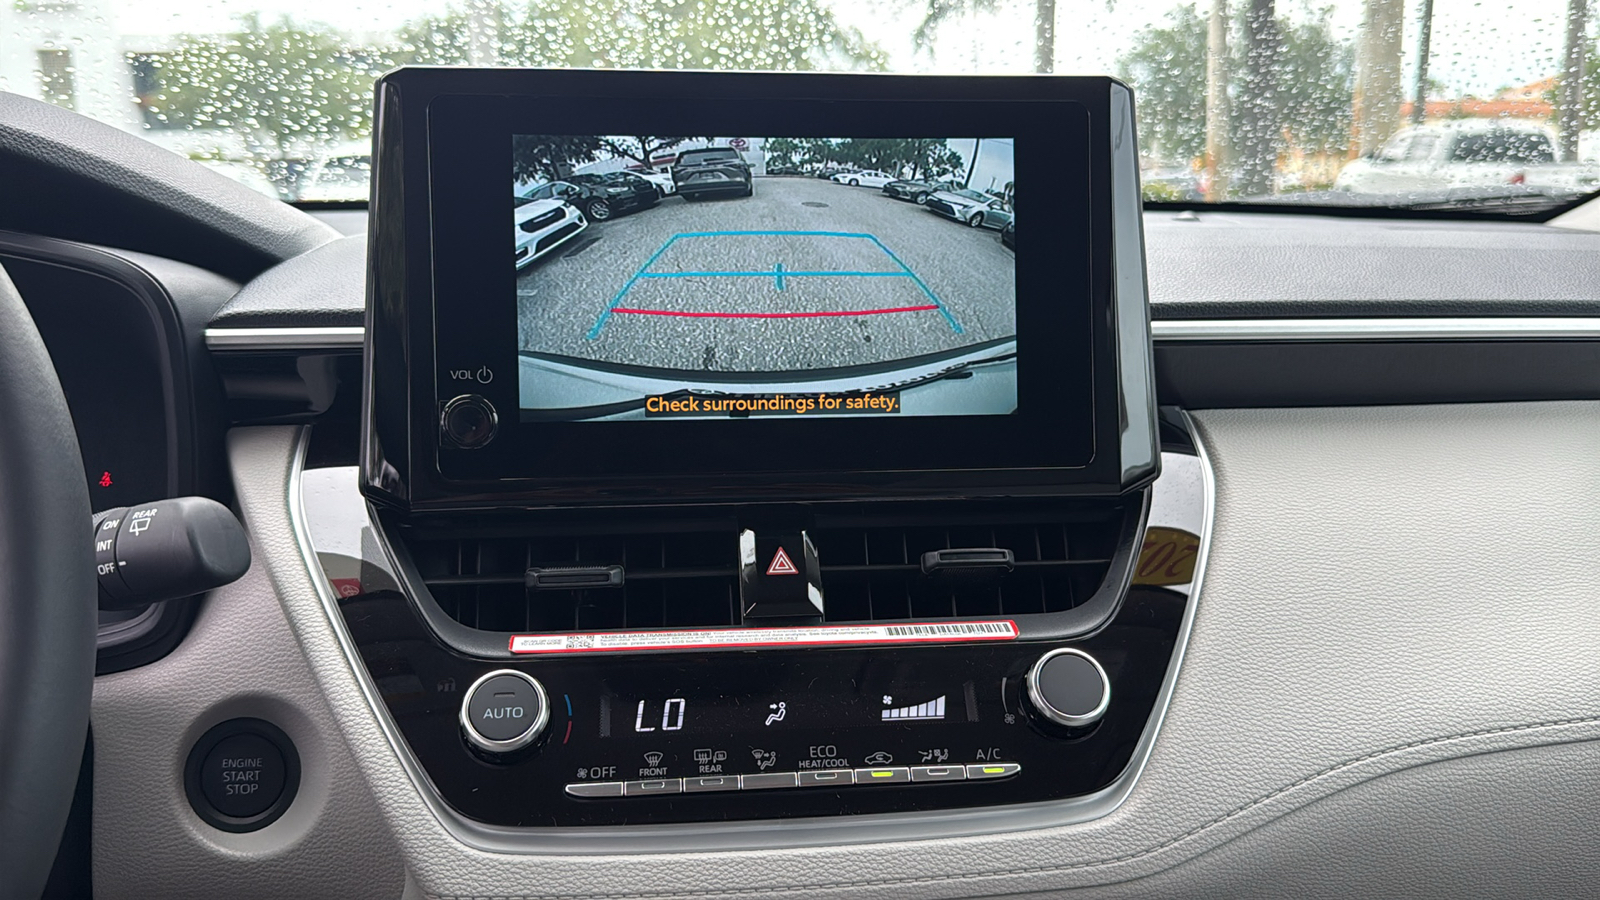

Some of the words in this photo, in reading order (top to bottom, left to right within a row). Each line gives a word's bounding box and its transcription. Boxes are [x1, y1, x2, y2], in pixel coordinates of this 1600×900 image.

[450, 369, 474, 380] VOL
[645, 395, 700, 413] Check
[702, 394, 815, 415] surroundings
[818, 393, 843, 411] for
[845, 393, 900, 414] safety.
[132, 508, 158, 520] REAR
[102, 519, 120, 530] ON
[96, 539, 113, 552] INT
[97, 562, 115, 575] OFF
[482, 706, 524, 719] AUTO
[809, 745, 837, 758] ECO
[976, 747, 1001, 761] A/C
[221, 757, 263, 769] ENGINE
[699, 764, 723, 774] REAR
[798, 757, 850, 769] HEAT/COOL
[222, 770, 261, 782] START
[590, 766, 617, 779] OFF
[639, 766, 668, 777] FRONT
[226, 783, 259, 795] STOP
